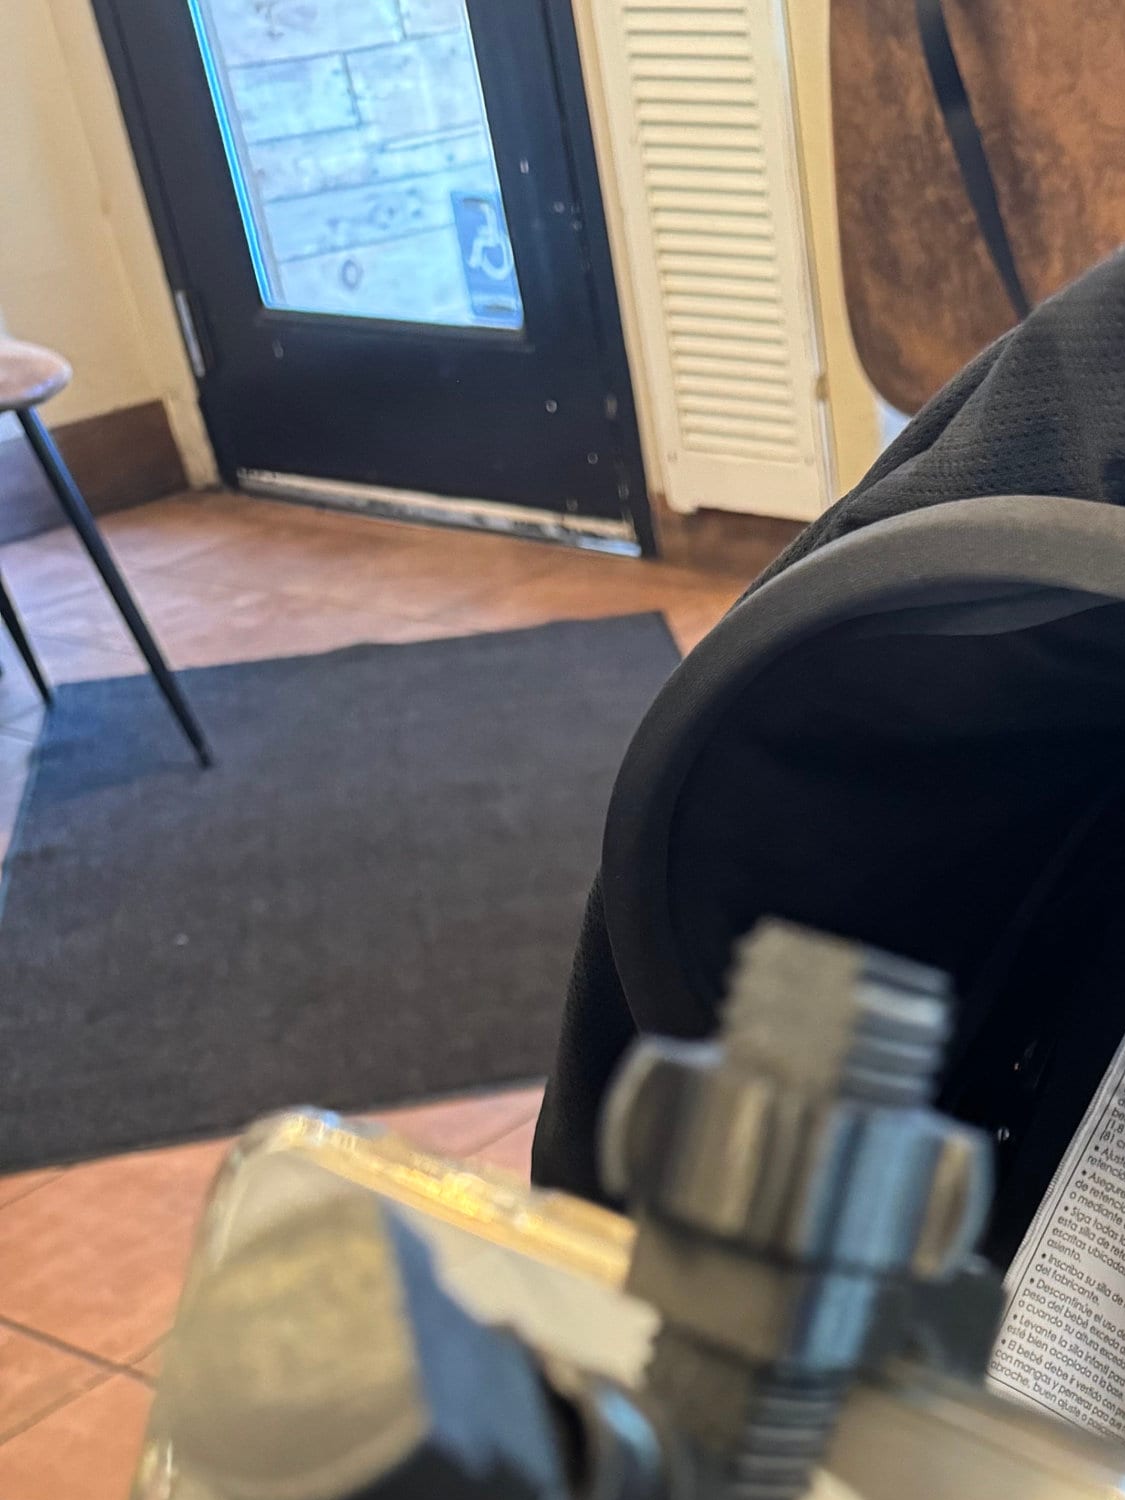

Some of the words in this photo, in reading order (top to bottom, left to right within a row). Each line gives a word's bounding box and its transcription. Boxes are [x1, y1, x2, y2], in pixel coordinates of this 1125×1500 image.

[1095, 1234, 1109, 1247] de
[1026, 1304, 1063, 1328] cuando
[1026, 1332, 1050, 1351] bien
[1043, 1359, 1069, 1379] debe
